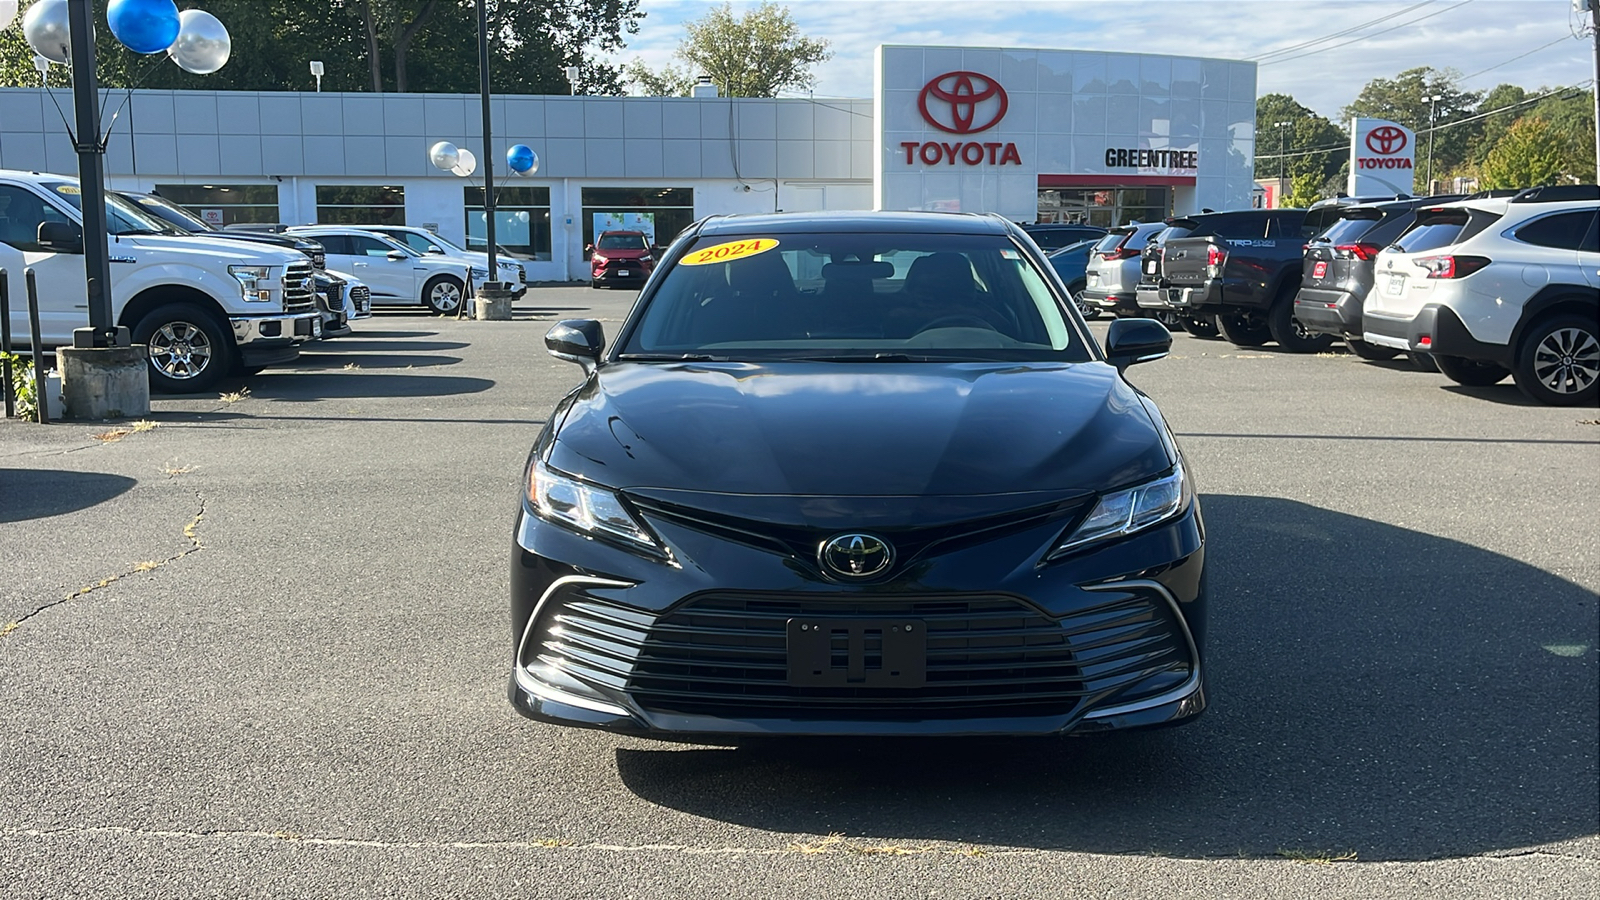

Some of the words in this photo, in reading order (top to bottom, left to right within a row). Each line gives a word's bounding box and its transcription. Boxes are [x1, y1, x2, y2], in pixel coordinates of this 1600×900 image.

[900, 141, 1022, 166] TOYOTA
[1105, 148, 1198, 169] GREENTREE
[1357, 157, 1413, 169] TOYOTA
[698, 240, 762, 263] 2024
